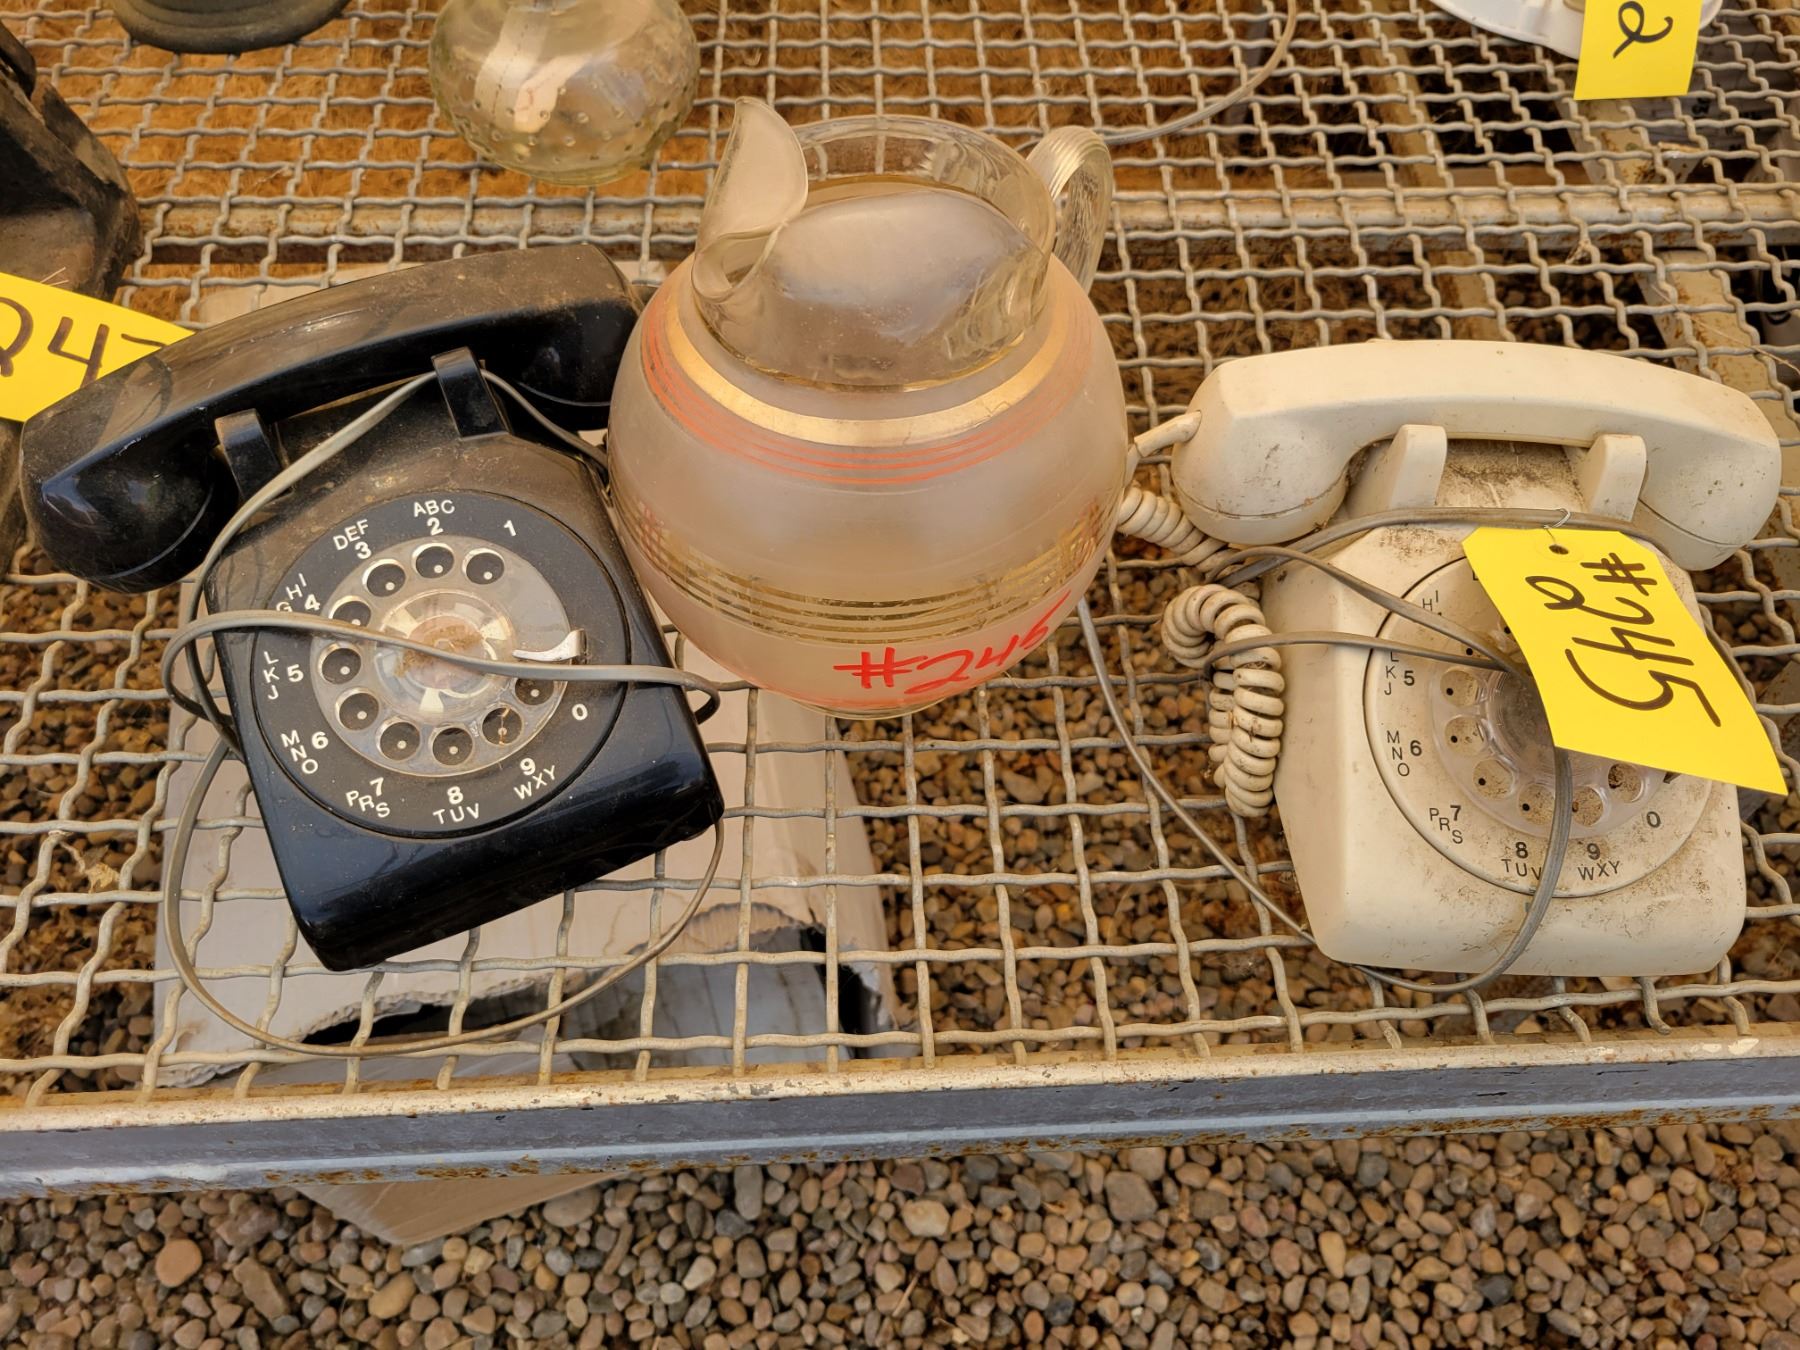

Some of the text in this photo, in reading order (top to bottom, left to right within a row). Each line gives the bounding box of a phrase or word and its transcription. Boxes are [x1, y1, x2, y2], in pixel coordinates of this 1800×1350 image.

[0, 296, 167, 389] 24
[413, 499, 456, 518] ABC
[333, 518, 369, 551] DEF
[427, 518, 444, 536] 2
[503, 520, 517, 537] 1
[354, 541, 372, 560] 3
[304, 593, 321, 611] 4
[1422, 589, 1439, 612] HI
[1525, 552, 1721, 727] #245
[287, 664, 305, 682] 5
[1403, 670, 1416, 687] 5
[310, 731, 330, 750] 6
[1410, 740, 1423, 757] 6
[519, 757, 537, 776] 9
[369, 777, 388, 798] 7
[513, 764, 558, 801] WXY
[345, 790, 391, 819] PRS
[447, 785, 465, 805] 8
[432, 803, 482, 826] TUV
[1450, 805, 1462, 821] 7
[1429, 807, 1464, 845] PRS
[1515, 842, 1529, 859] 8
[1586, 843, 1601, 861] 9
[1577, 860, 1621, 881] WXY
